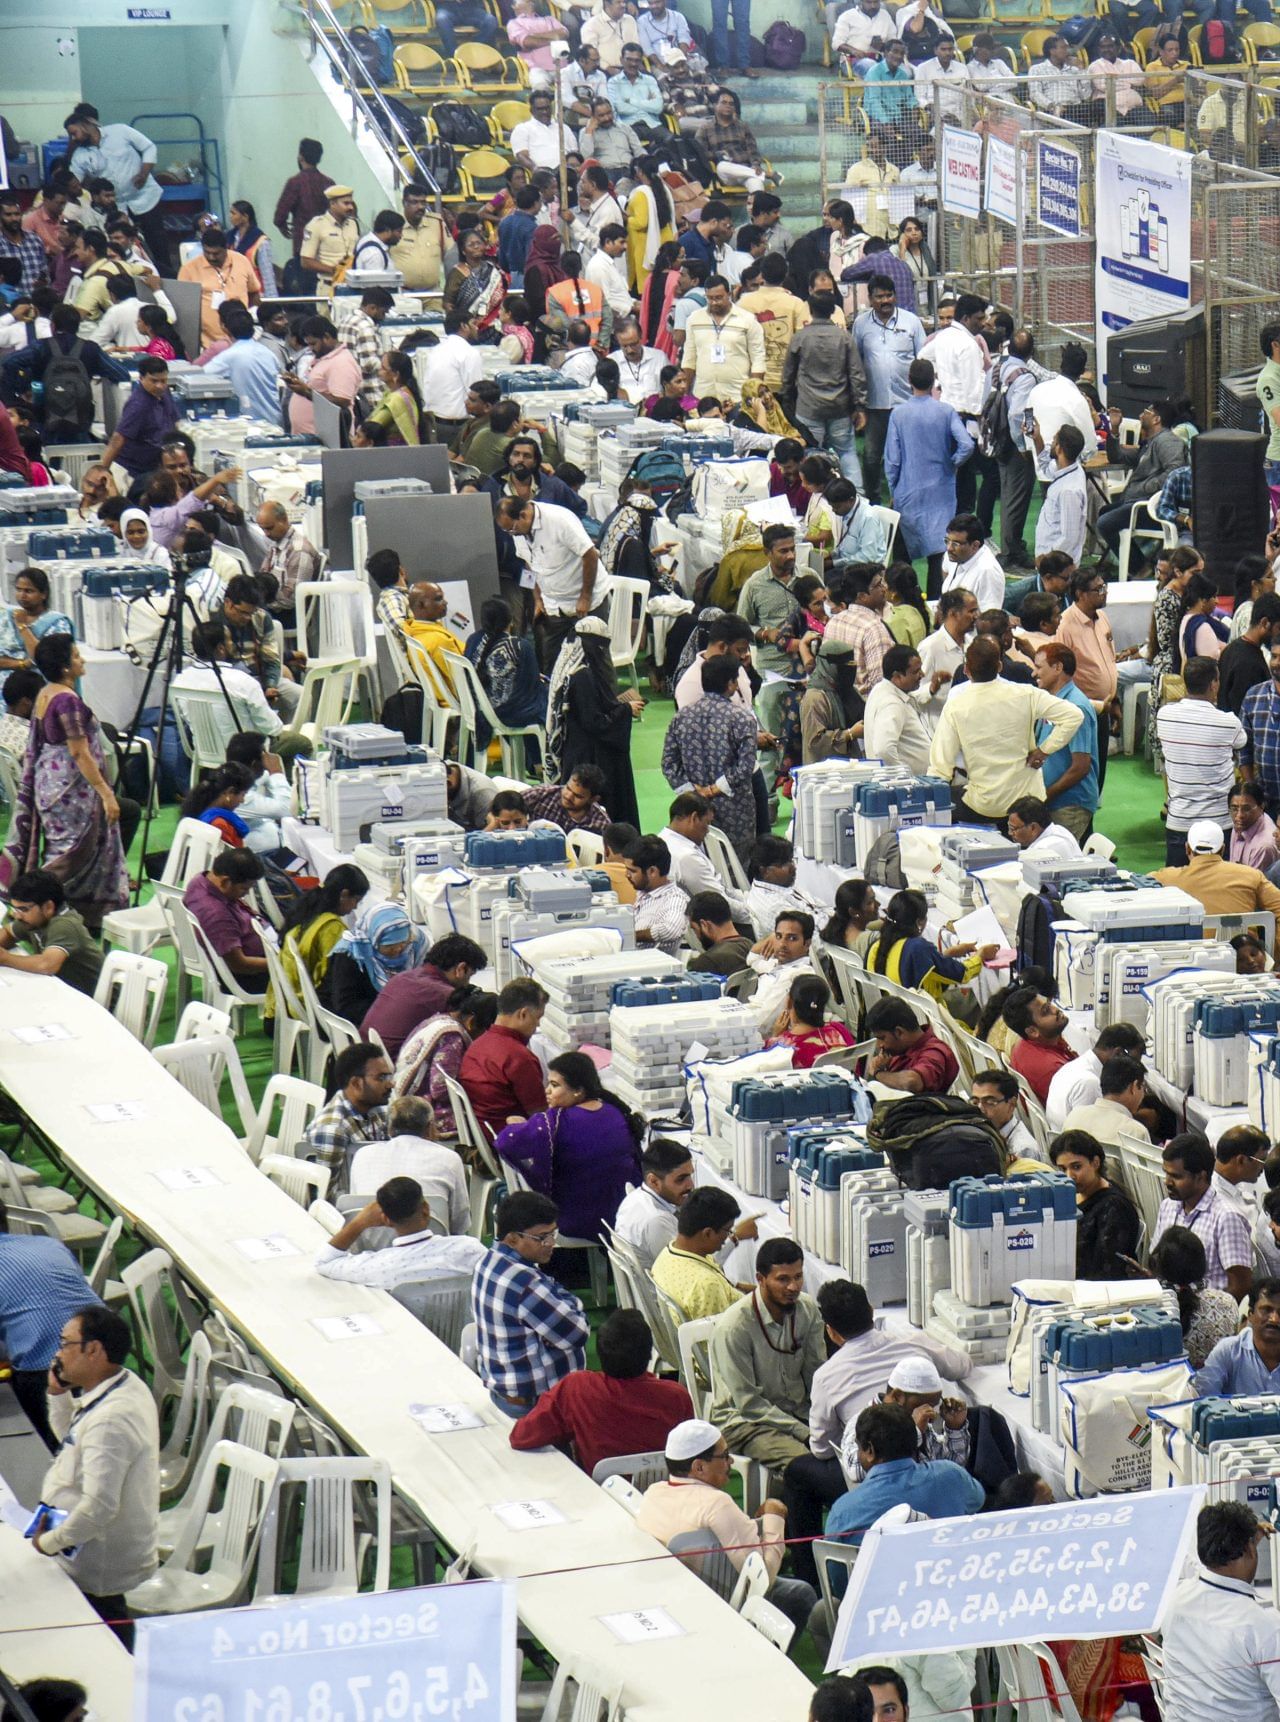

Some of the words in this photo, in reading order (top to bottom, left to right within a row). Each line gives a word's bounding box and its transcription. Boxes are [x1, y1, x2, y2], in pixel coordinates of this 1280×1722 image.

[1263, 386, 1274, 401] 3
[1123, 984, 1140, 994] BU-0
[1007, 1236, 1034, 1249] PS-028
[1116, 1450, 1152, 1463] BYE-ELECT
[1108, 1469, 1152, 1483] CONSTITUEN
